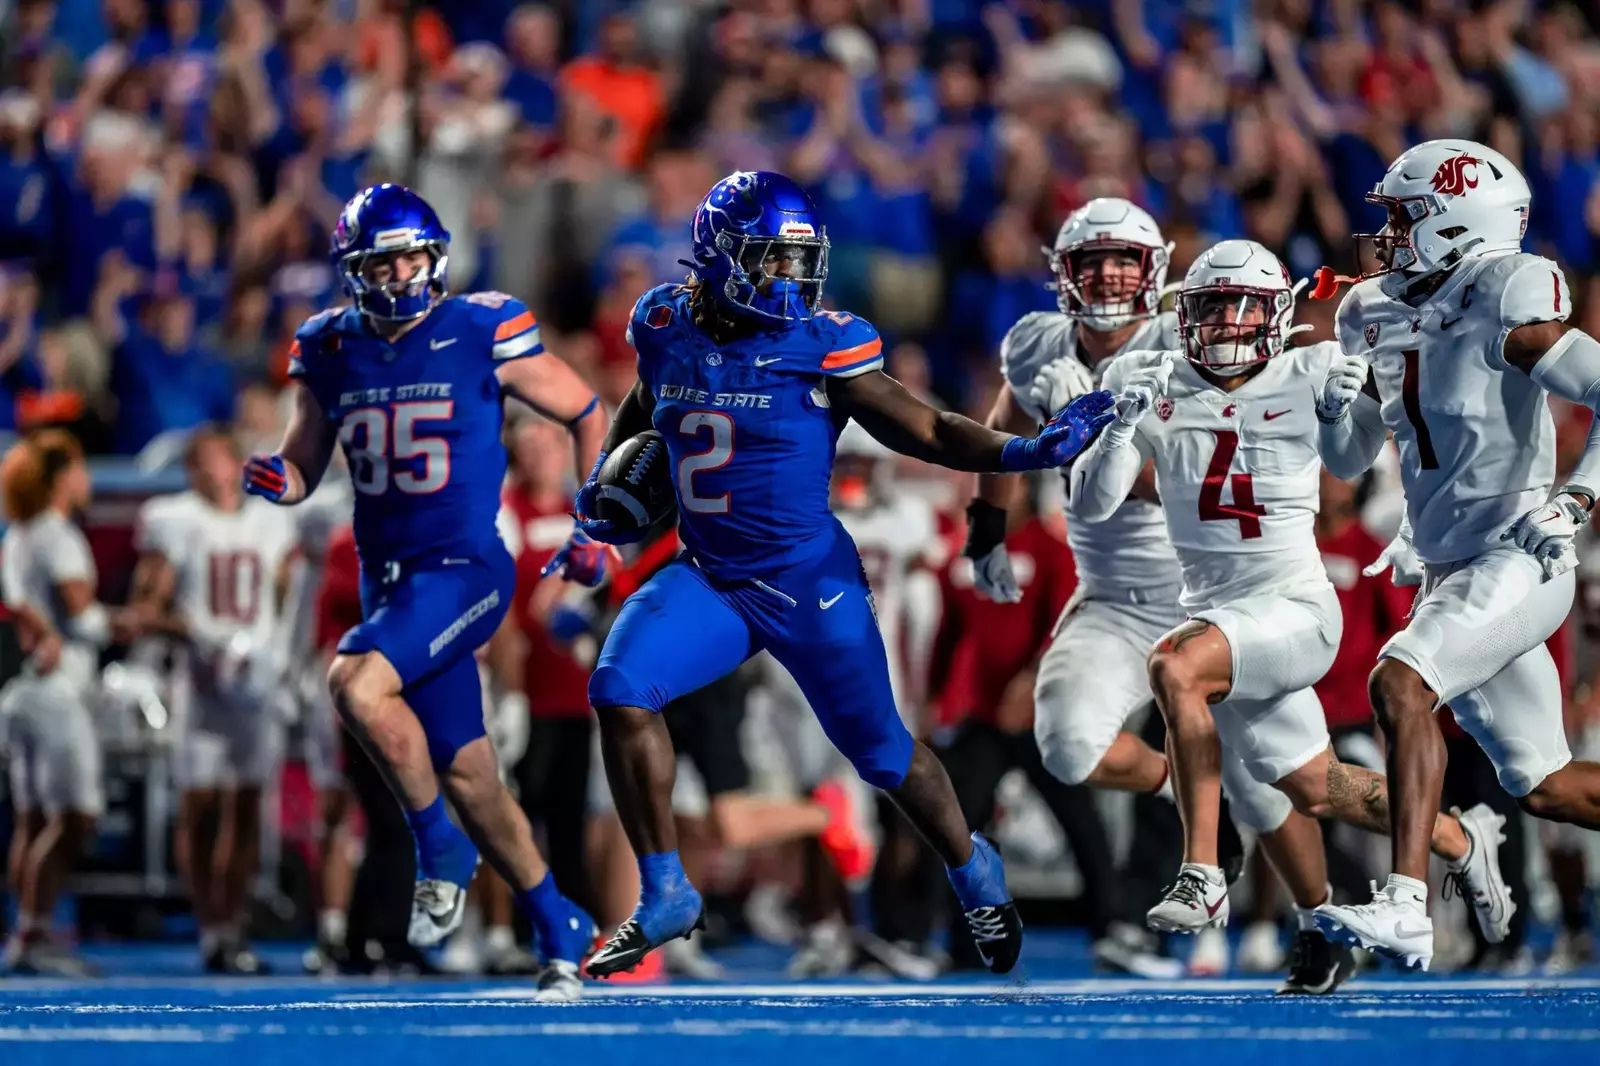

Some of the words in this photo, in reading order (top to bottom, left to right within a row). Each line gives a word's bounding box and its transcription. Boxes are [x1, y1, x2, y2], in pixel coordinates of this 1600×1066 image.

[396, 382, 453, 400] STATE
[711, 393, 773, 409] STATE
[1401, 349, 1440, 470] 1
[678, 409, 736, 515] 2
[1198, 429, 1267, 540] 4
[429, 589, 500, 658] BRONCOS
